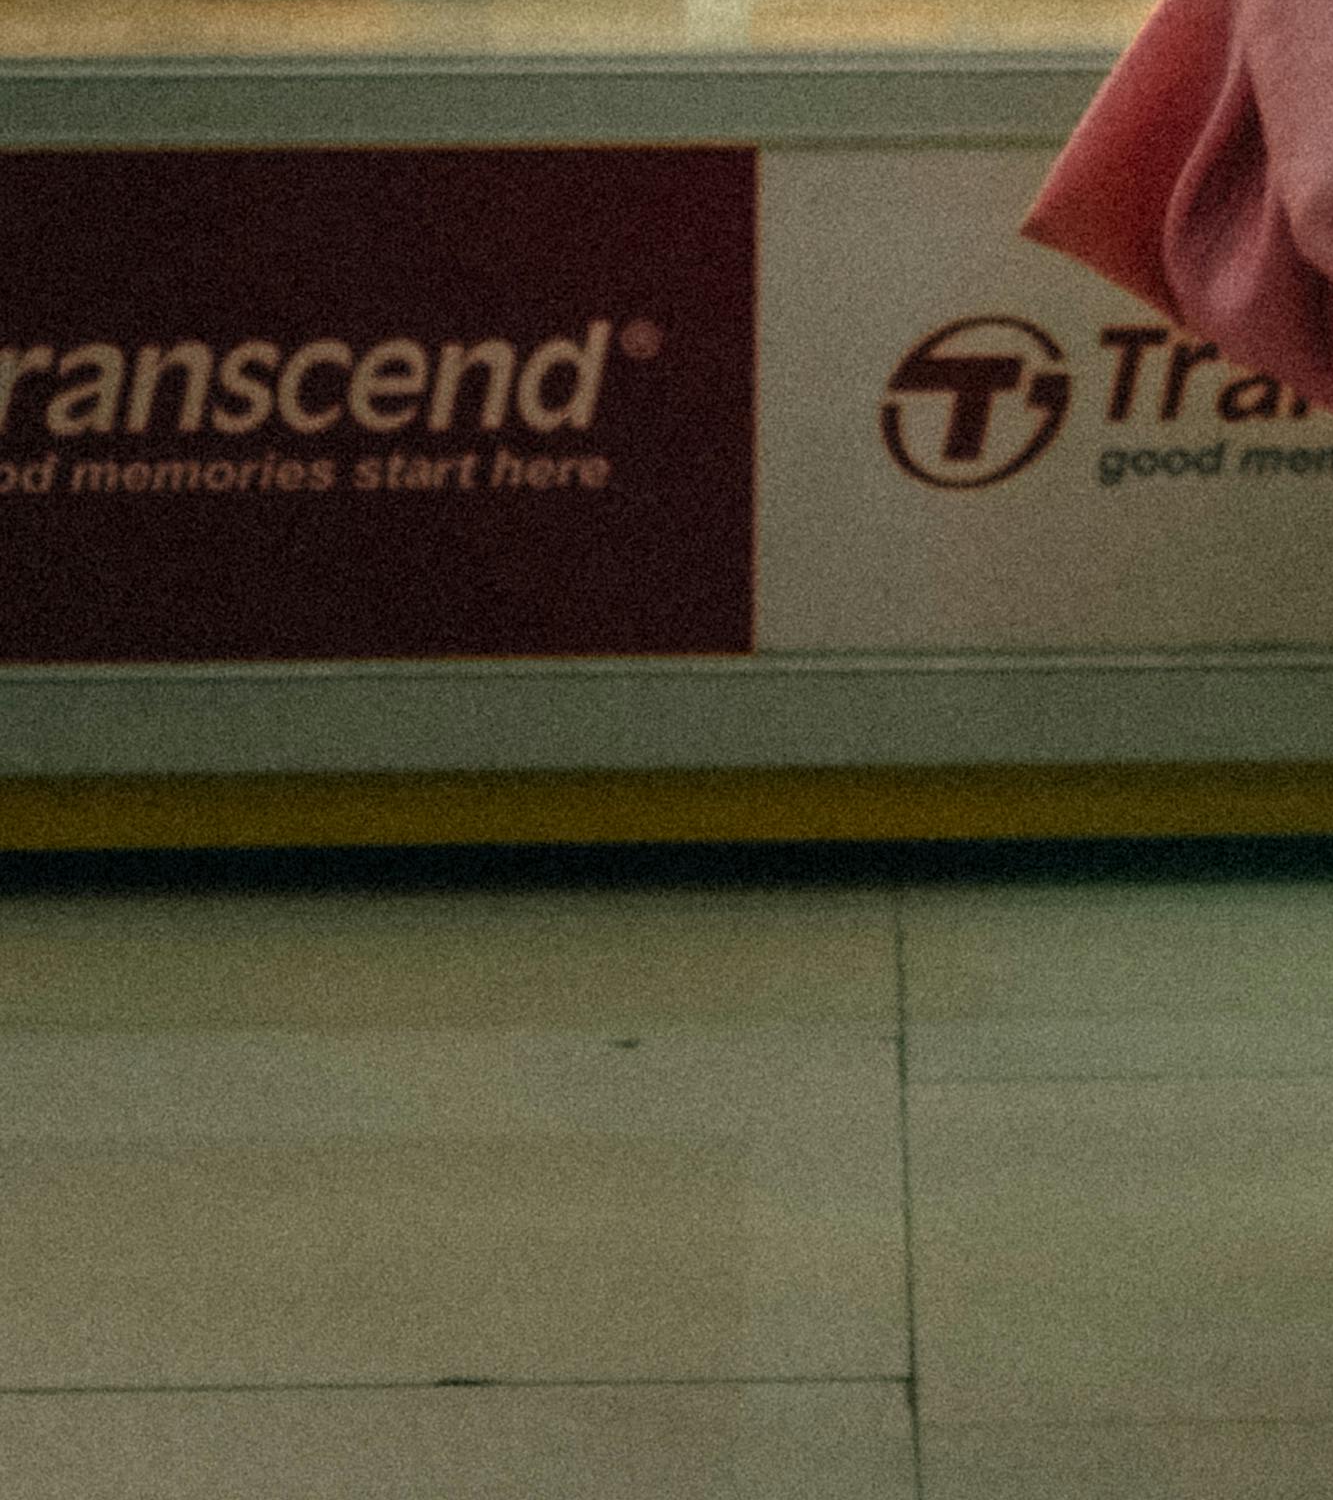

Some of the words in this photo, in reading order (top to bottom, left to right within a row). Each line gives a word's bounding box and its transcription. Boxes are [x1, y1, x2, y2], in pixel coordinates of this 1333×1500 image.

[1100, 326, 1308, 422] Tra
[69, 452, 336, 493] memories
[353, 452, 482, 492] start
[491, 448, 612, 490] here
[1098, 440, 1227, 486] good
